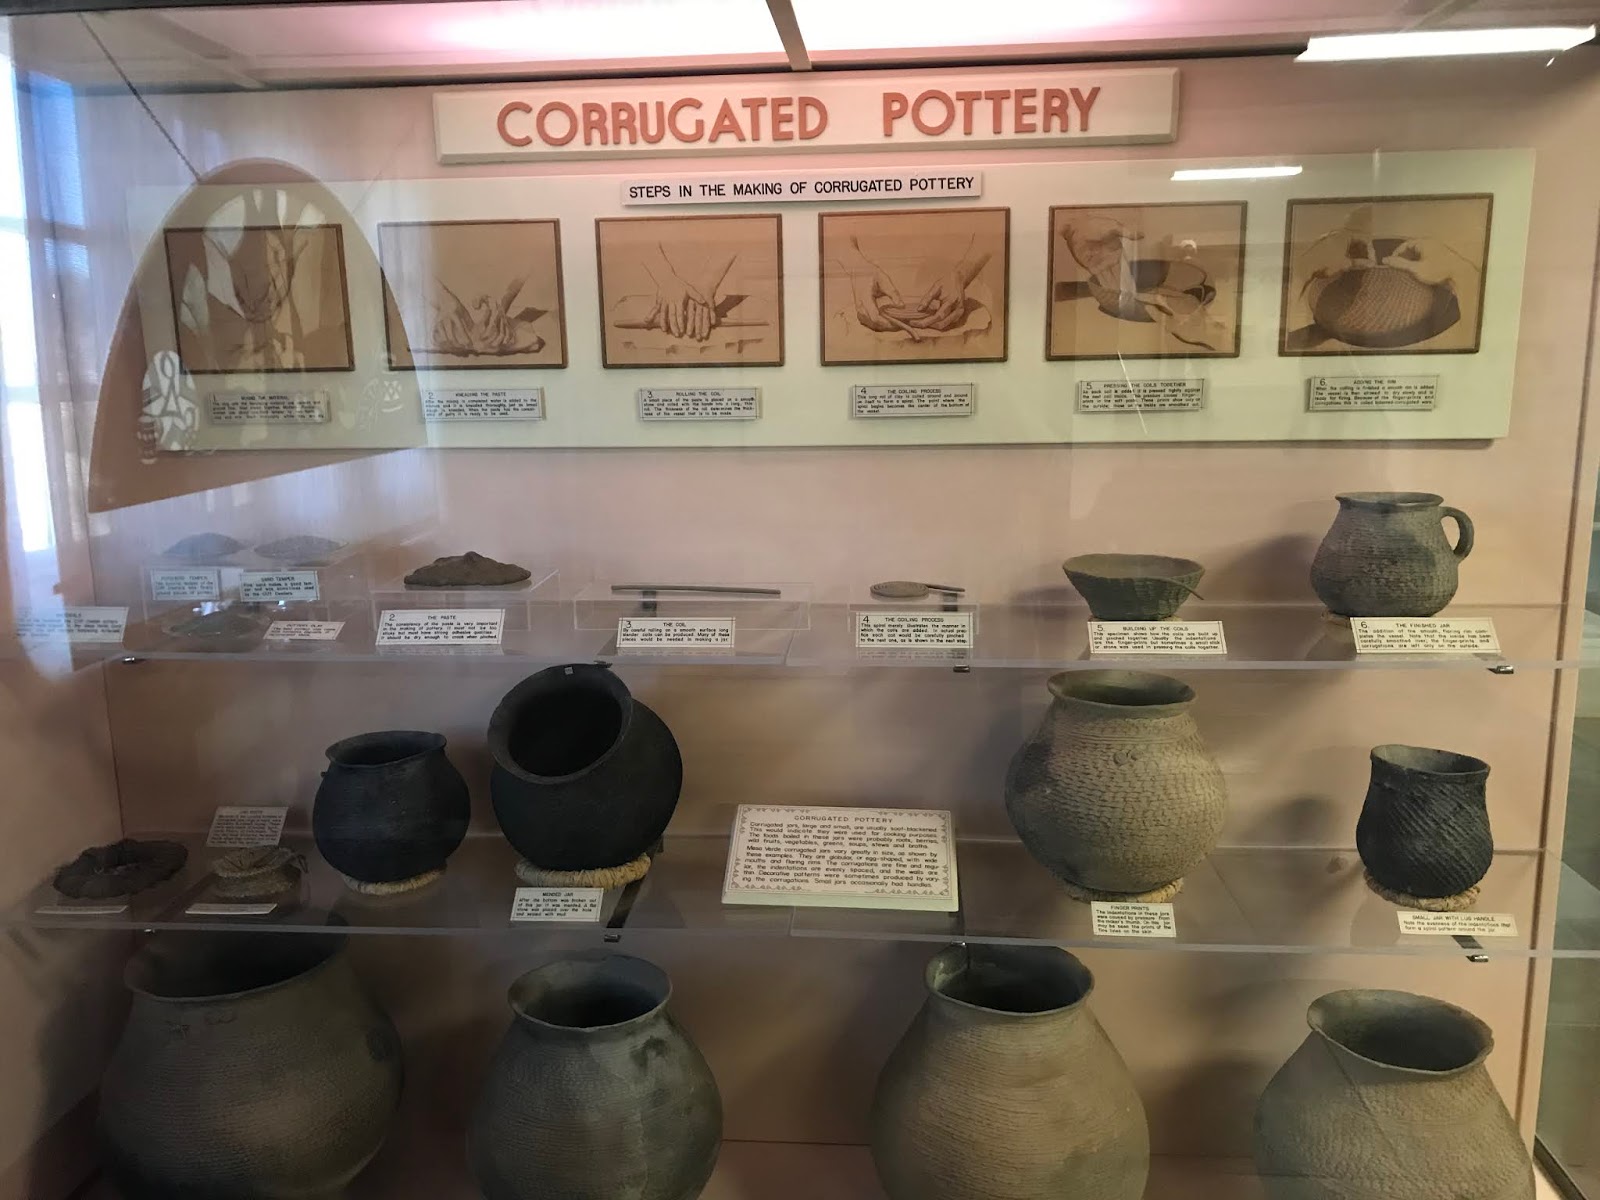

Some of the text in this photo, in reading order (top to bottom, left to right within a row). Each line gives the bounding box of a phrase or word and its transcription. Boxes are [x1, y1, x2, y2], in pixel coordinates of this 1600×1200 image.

[497, 87, 1101, 147] CORRUGATED POTTERY
[629, 176, 975, 198] STEPS IN THE MAKING OF CORRUGATED POTTERY
